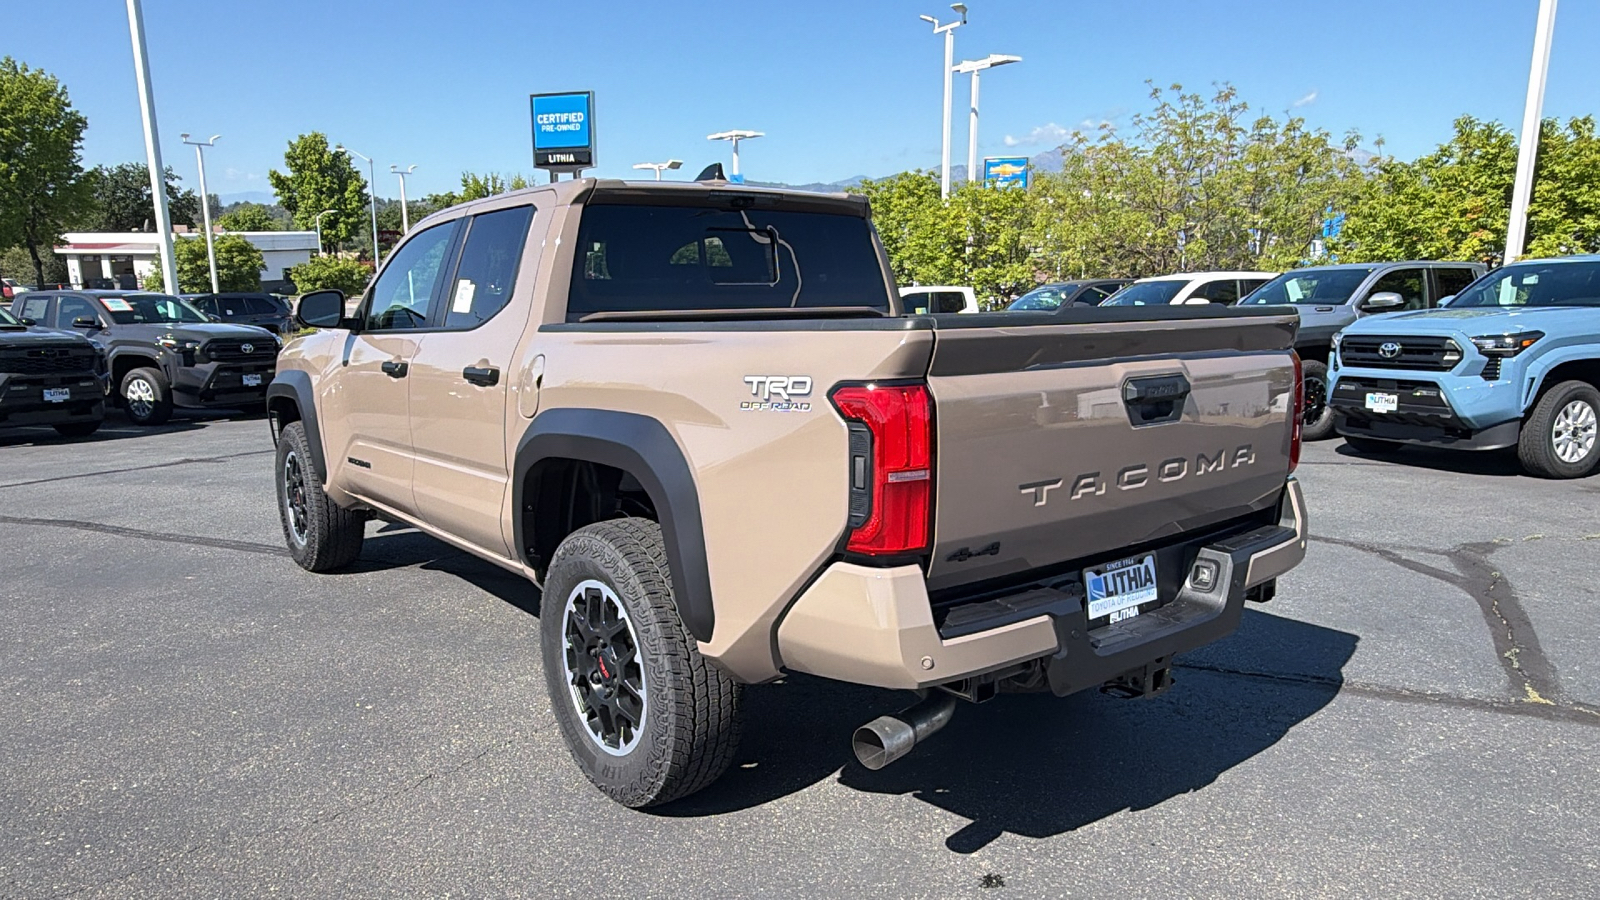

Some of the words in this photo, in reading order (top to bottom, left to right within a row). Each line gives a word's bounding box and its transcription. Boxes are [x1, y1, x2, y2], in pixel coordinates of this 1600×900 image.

[537, 112, 584, 124] CERTIFIED
[541, 123, 581, 132] PRE-OWNED
[548, 153, 575, 163] LITHIA
[743, 375, 813, 402] TRD
[740, 401, 769, 411] OFF
[770, 401, 812, 412] ROAD
[1373, 396, 1396, 405] LITHIA
[1018, 444, 1256, 507] TACOMA
[1106, 561, 1121, 571] SINCE
[1102, 564, 1154, 598] LITHIA
[1091, 599, 1116, 612] TOYOTA
[1117, 595, 1126, 605] OF
[1126, 588, 1155, 601] REDDING
[1116, 605, 1139, 622] LITHIA
